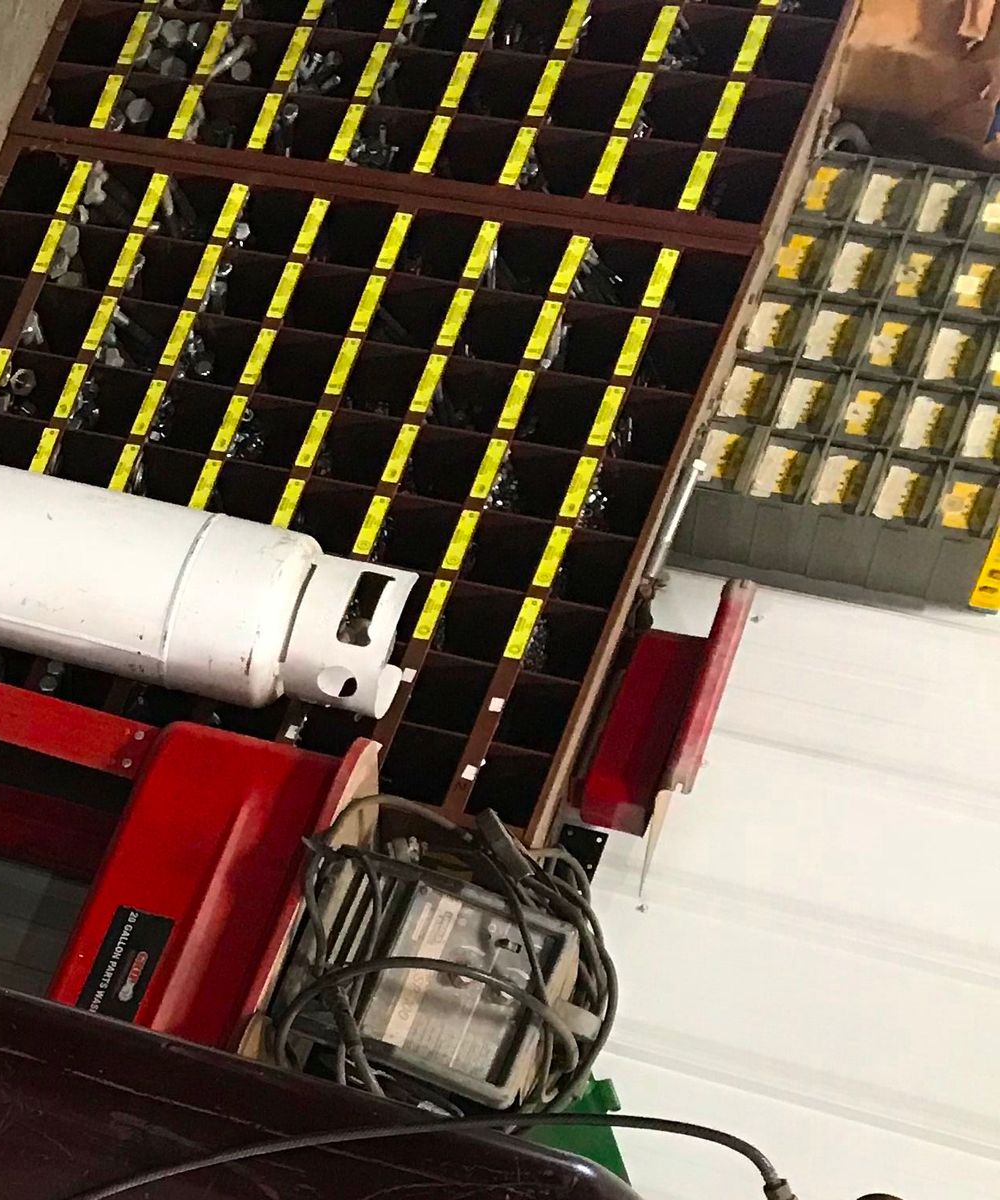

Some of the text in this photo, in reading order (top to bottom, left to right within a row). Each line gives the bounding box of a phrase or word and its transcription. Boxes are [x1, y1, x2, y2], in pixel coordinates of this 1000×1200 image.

[89, 911, 138, 1013] 20 GALLON PARTS WAS
